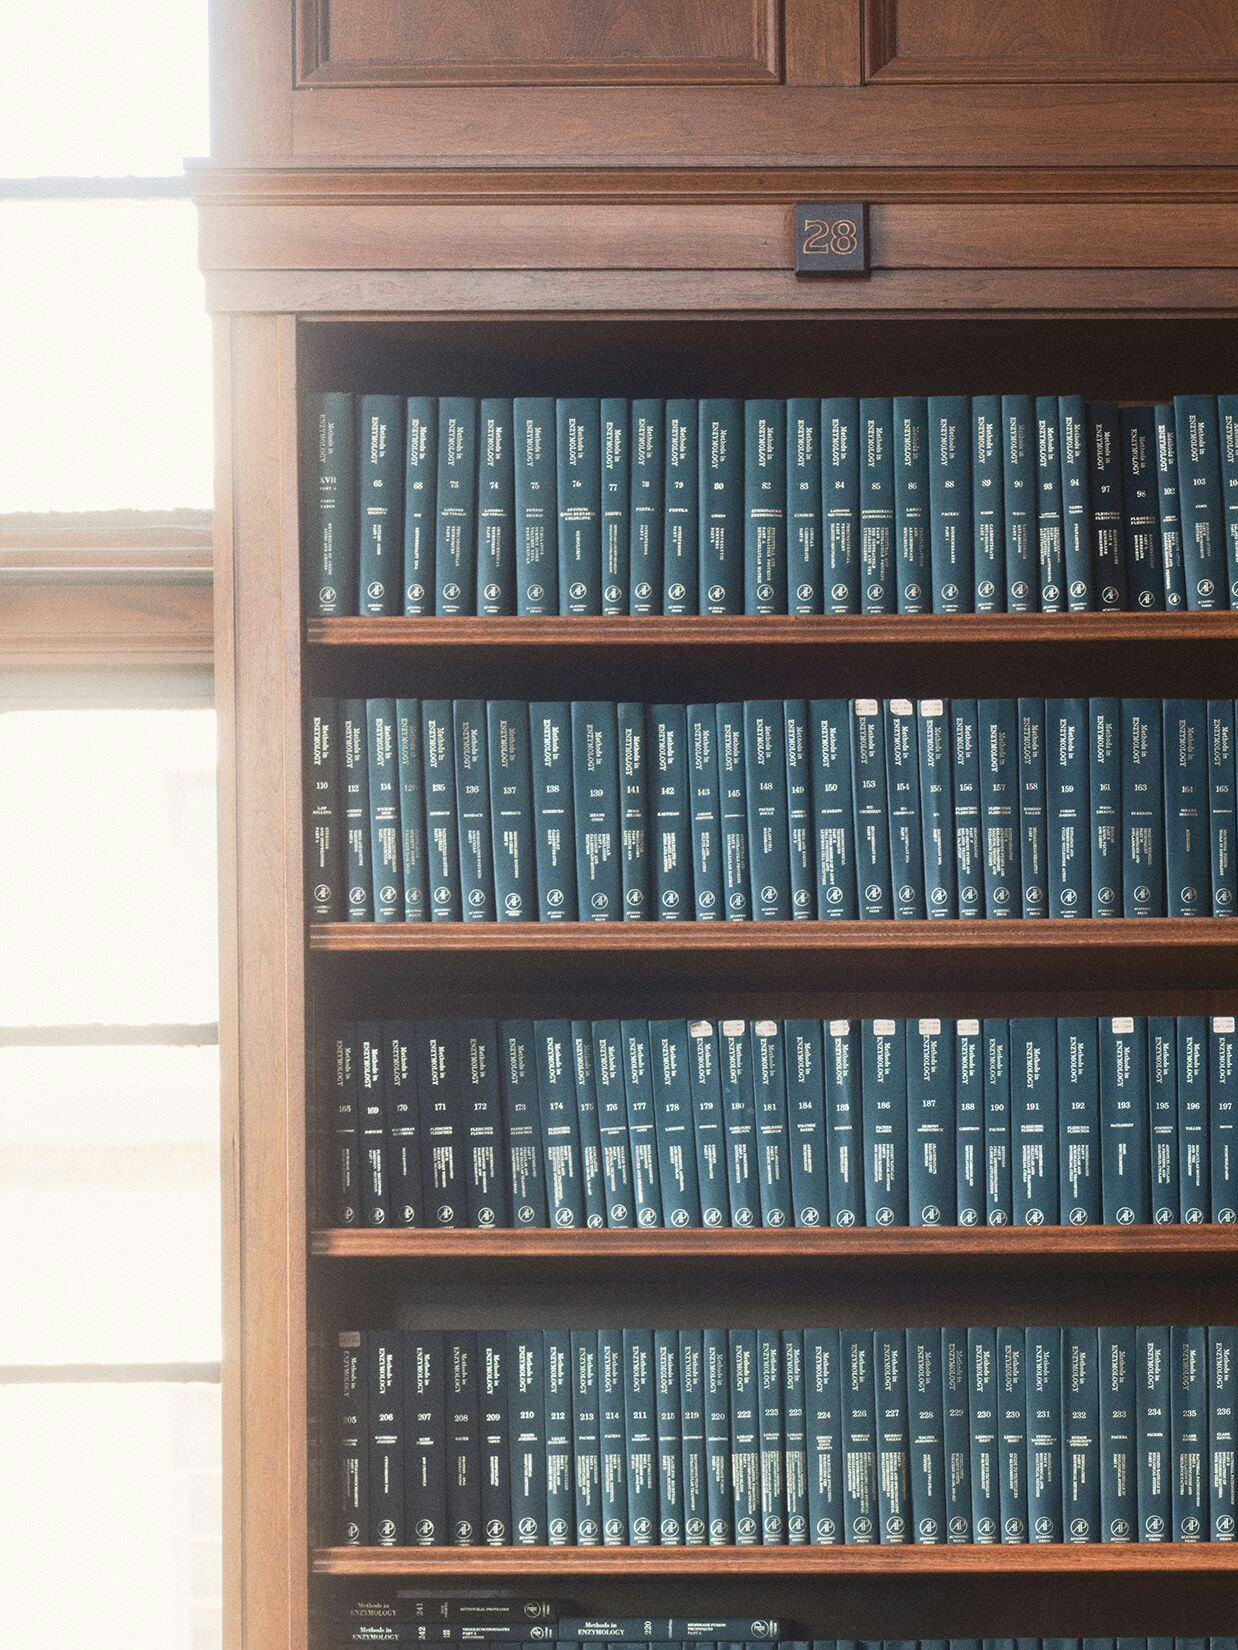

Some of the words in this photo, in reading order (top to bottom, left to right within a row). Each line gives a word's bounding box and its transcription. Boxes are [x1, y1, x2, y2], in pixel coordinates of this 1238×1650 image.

[803, 220, 857, 255] 28
[835, 481, 844, 489] 84
[661, 787, 675, 795] 142
[825, 784, 837, 792] 150
[666, 1104, 680, 1112] 178
